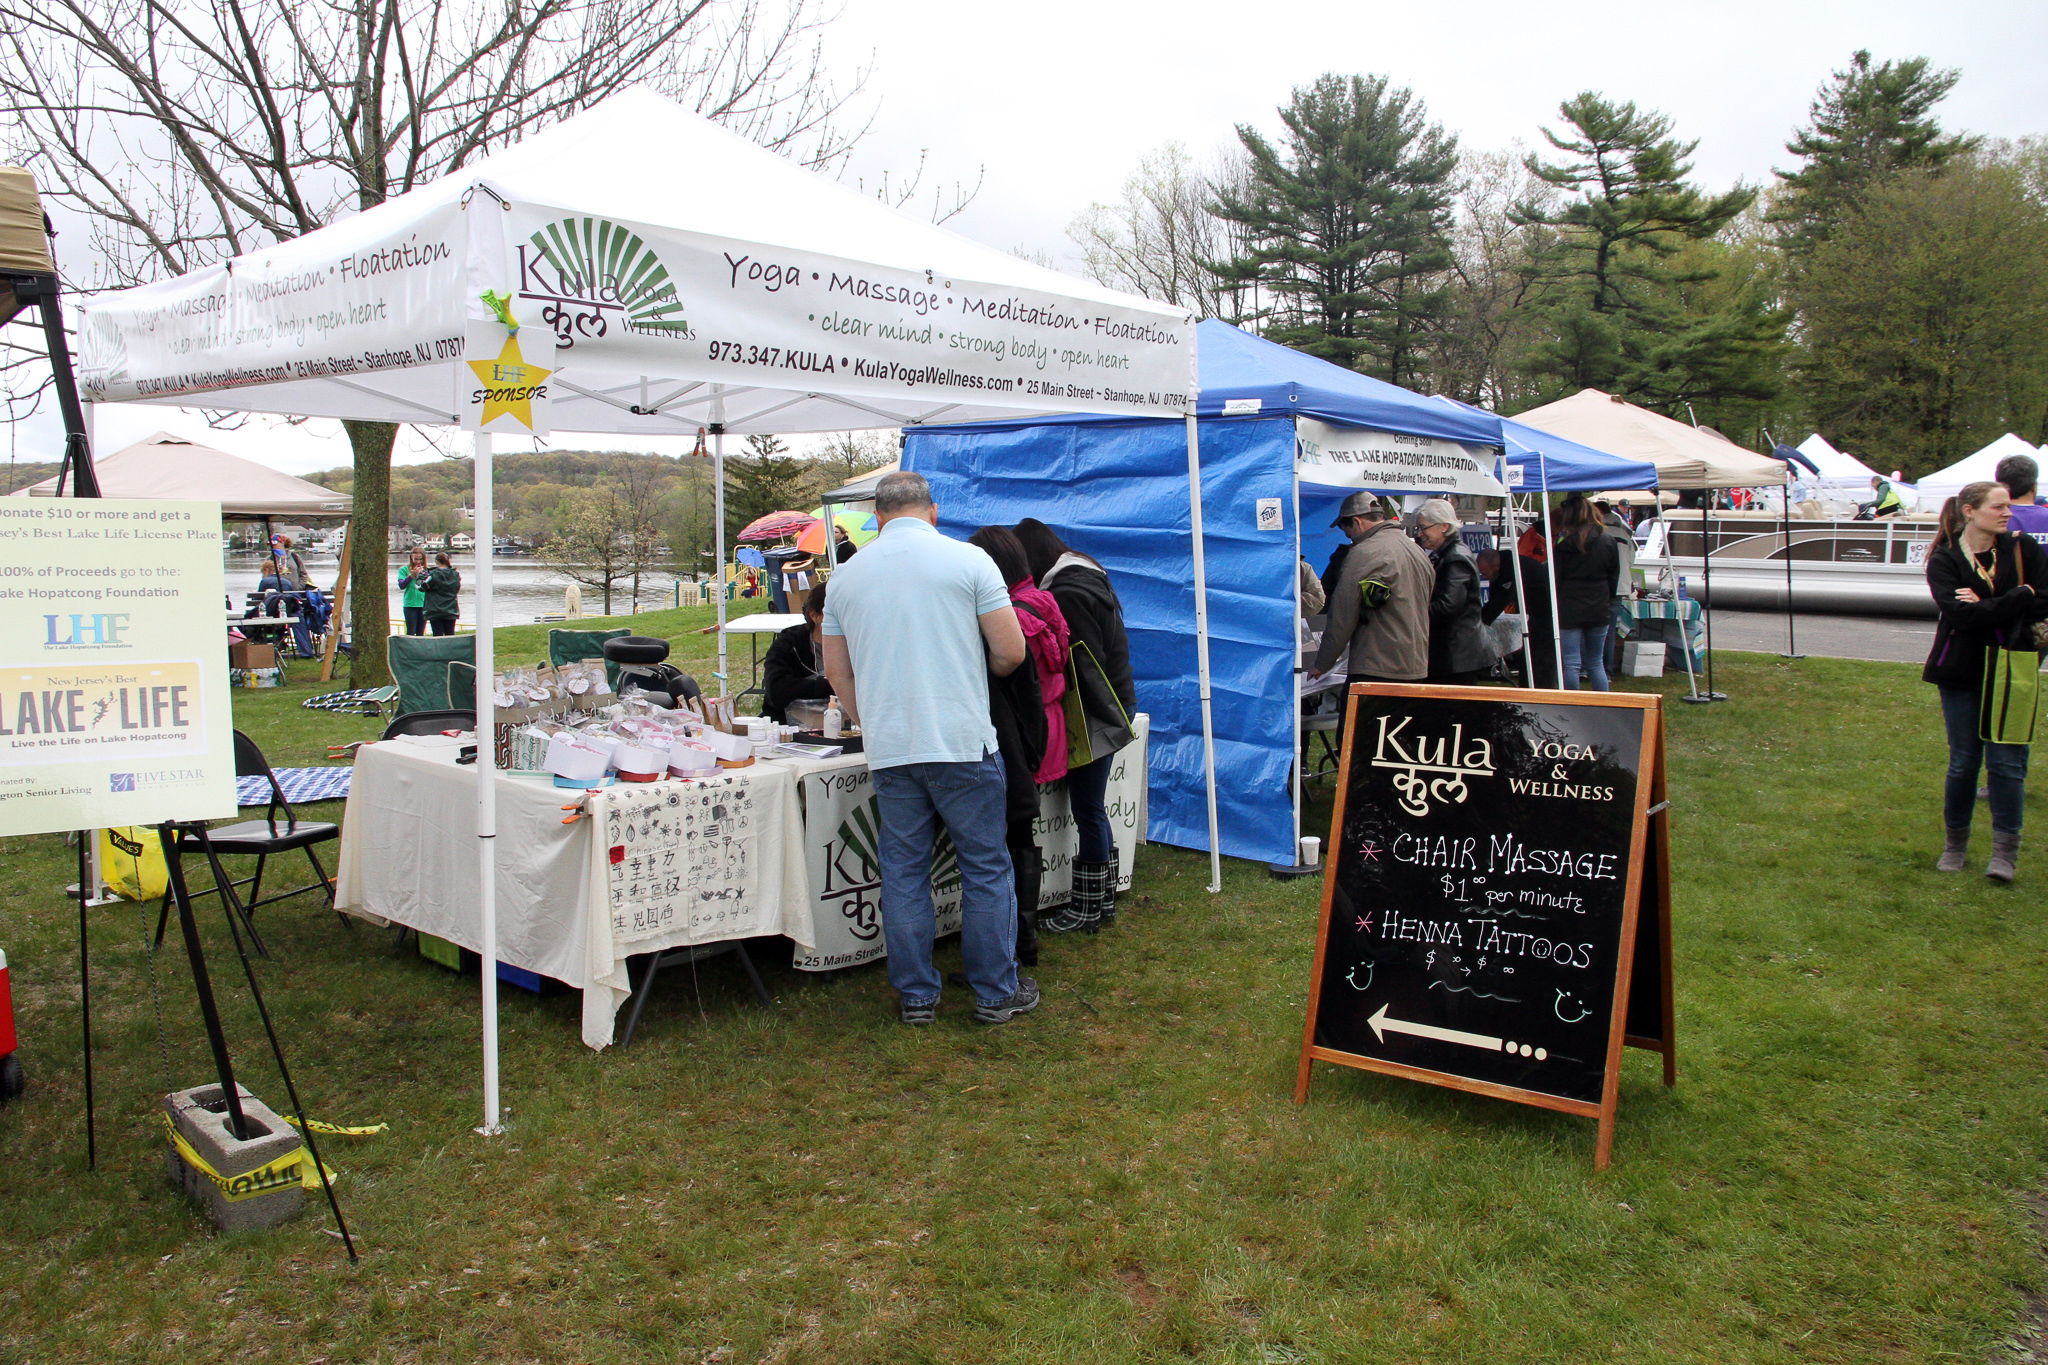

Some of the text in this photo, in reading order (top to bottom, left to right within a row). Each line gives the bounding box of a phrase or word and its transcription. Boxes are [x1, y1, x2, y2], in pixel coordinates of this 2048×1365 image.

[133, 307, 160, 335] Yoga
[245, 266, 325, 307] Meditation
[340, 233, 450, 283] Floatation
[515, 244, 627, 306] Kula
[630, 281, 682, 305] YOGA
[724, 252, 1179, 345] Yoga Massage Meditation Floatation
[236, 323, 274, 348] strong
[276, 312, 305, 347] body
[316, 310, 346, 341] open
[348, 298, 387, 325] heart
[651, 306, 666, 321] &
[621, 317, 697, 342] WELLNESS
[821, 311, 1130, 372] clear mind strong body open heart
[190, 364, 288, 391] KulaYogaWellness.com
[305, 358, 329, 377] Main
[328, 355, 357, 373] Street
[364, 349, 417, 369] Stanhope,
[415, 342, 432, 363] NJ
[435, 336, 465, 359] 0787
[708, 340, 1188, 407] 973.347.KULA KulaYogaWellness.com 25 Main Street Stanhope, NJ 07874
[471, 386, 548, 405] SPONSOR
[1328, 450, 1352, 463] THE
[1352, 450, 1381, 464] LAKE
[1382, 451, 1424, 467] HOPATCONG
[1363, 470, 1379, 481] Once
[1380, 471, 1397, 483] Again
[1397, 472, 1417, 484] Serving
[1417, 473, 1427, 483] The
[0, 507, 191, 522] onate $10 or more and get a
[33, 527, 63, 538] Best
[67, 528, 100, 539] Lake
[104, 529, 130, 539] Life
[134, 529, 183, 540] License
[186, 530, 218, 540] Plate
[38, 566, 52, 577] of
[56, 566, 117, 578] Proceeds
[120, 569, 136, 579] go
[140, 567, 152, 577] to
[156, 566, 181, 577] the:
[28, 588, 102, 600] Hopatcong
[106, 587, 179, 598] Foundation
[43, 613, 130, 645] LHF
[47, 674, 137, 687] New Jersey's Best
[0, 685, 190, 736] LAKE LIFE
[11, 740, 35, 748] Live
[38, 738, 57, 747] the
[60, 737, 82, 746] Life
[101, 735, 127, 743] Lake
[130, 732, 187, 742] Hopatcong
[1372, 715, 1497, 770] Kula
[1528, 738, 1597, 762] YOGA
[25, 777, 38, 785] By:
[136, 769, 205, 783] FIVE STAR
[1550, 763, 1569, 781] &
[26, 788, 58, 798] Senior
[60, 786, 92, 797] Living
[819, 771, 869, 799] Yoga
[1509, 777, 1615, 802] WELLNESS
[1393, 832, 1618, 880] CHAIR MASSAGE
[1485, 890, 1514, 906] per
[1519, 887, 1586, 914] minute
[1382, 910, 1594, 969] HENNA TATTOOS
[804, 943, 885, 967] 25 Main Street
